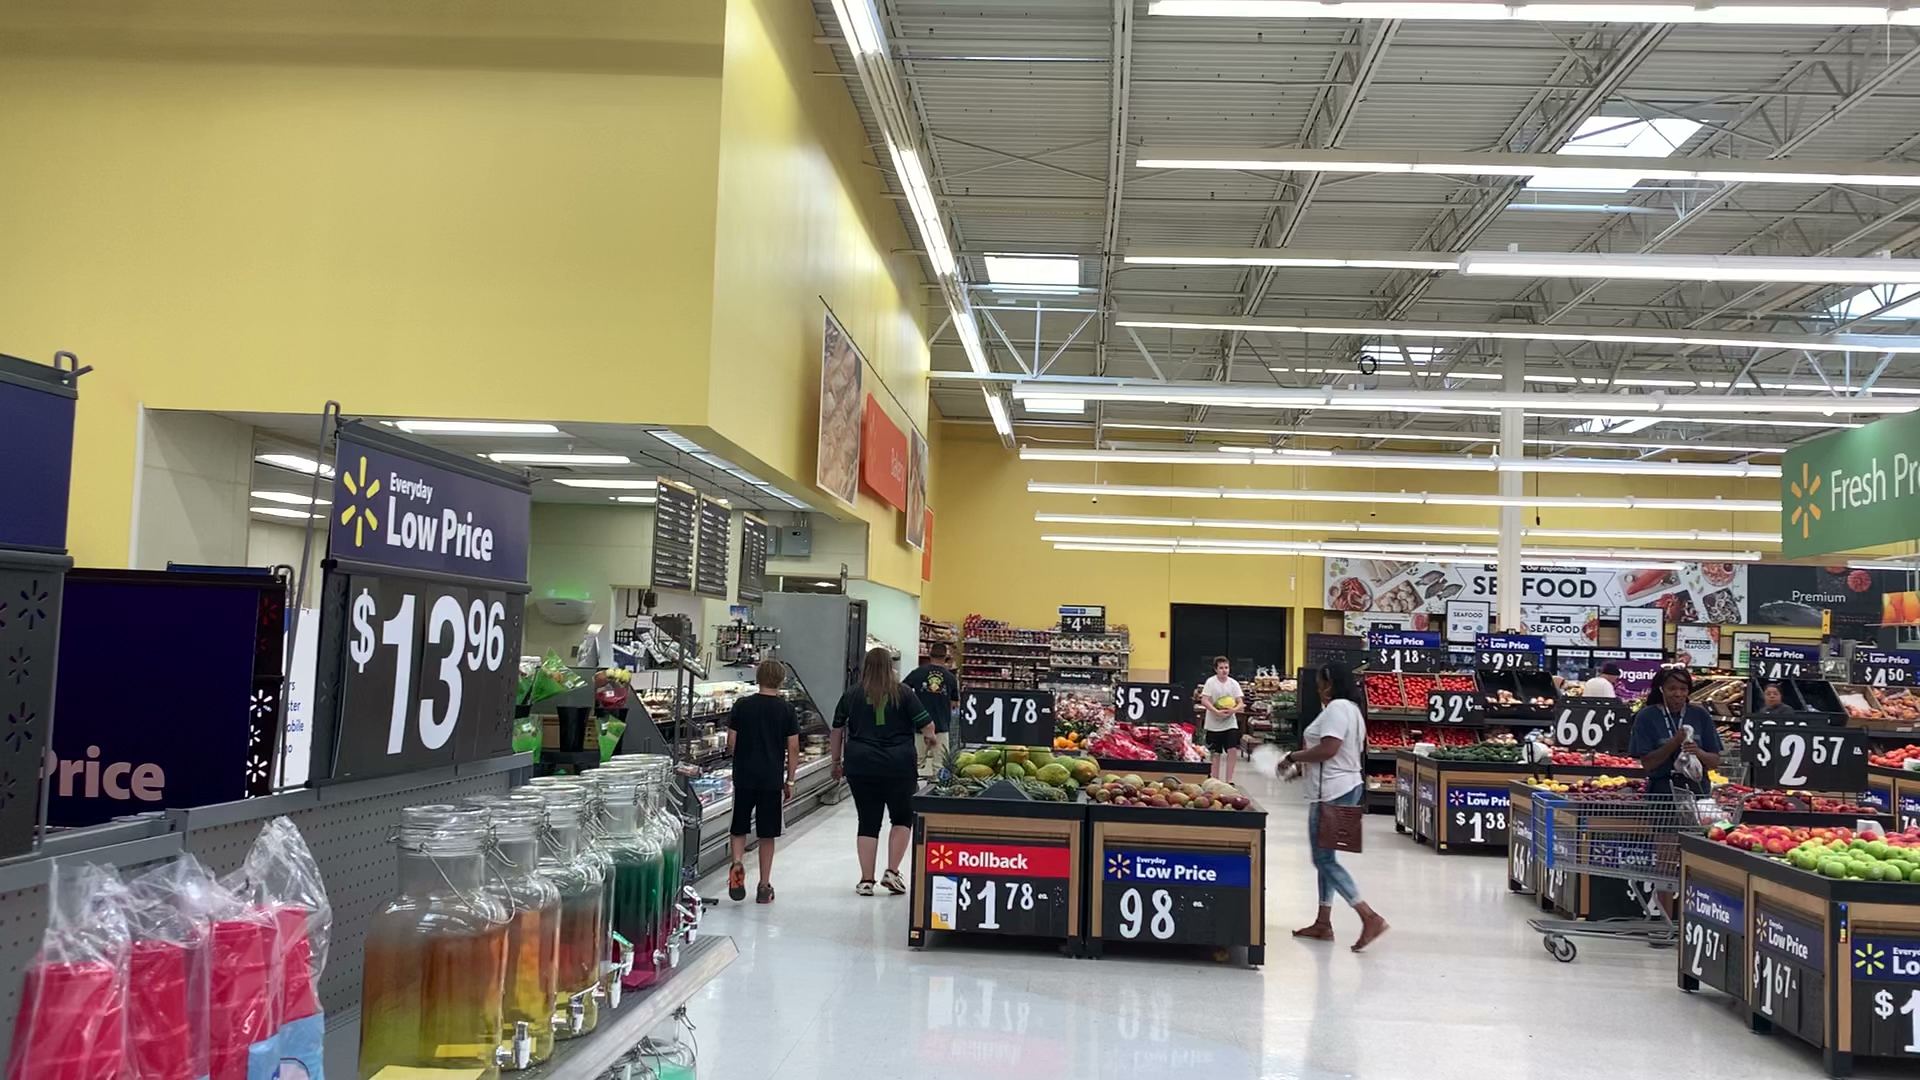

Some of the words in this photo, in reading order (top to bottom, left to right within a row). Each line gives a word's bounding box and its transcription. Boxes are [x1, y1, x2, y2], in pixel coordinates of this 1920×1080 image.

[389, 472, 433, 504] Everyday
[1831, 458, 1886, 511] Fresh
[1894, 453, 1920, 498] Pr
[386, 496, 439, 552] Low
[441, 508, 494, 562] Price
[1473, 575, 1597, 599] SEFOOD
[1791, 590, 1847, 603] Premium
[1530, 624, 1580, 634] SEAFOOD
[1403, 638, 1425, 646] Price
[1490, 640, 1508, 649] Low
[1509, 641, 1530, 650] Price
[1765, 649, 1782, 658] Low
[1783, 650, 1805, 659] Price
[1869, 654, 1887, 663] Low
[1888, 656, 1910, 664] Price
[286, 719, 304, 732] obile
[1467, 797, 1490, 806] Low
[1491, 797, 1510, 807] Pric
[958, 851, 1028, 869] Rollback
[1136, 863, 1172, 879] Low
[1174, 864, 1217, 881] Price
[1696, 897, 1712, 916] Low
[1711, 903, 1730, 924] Price
[1768, 928, 1786, 948] Low
[1786, 933, 1809, 960] Price
